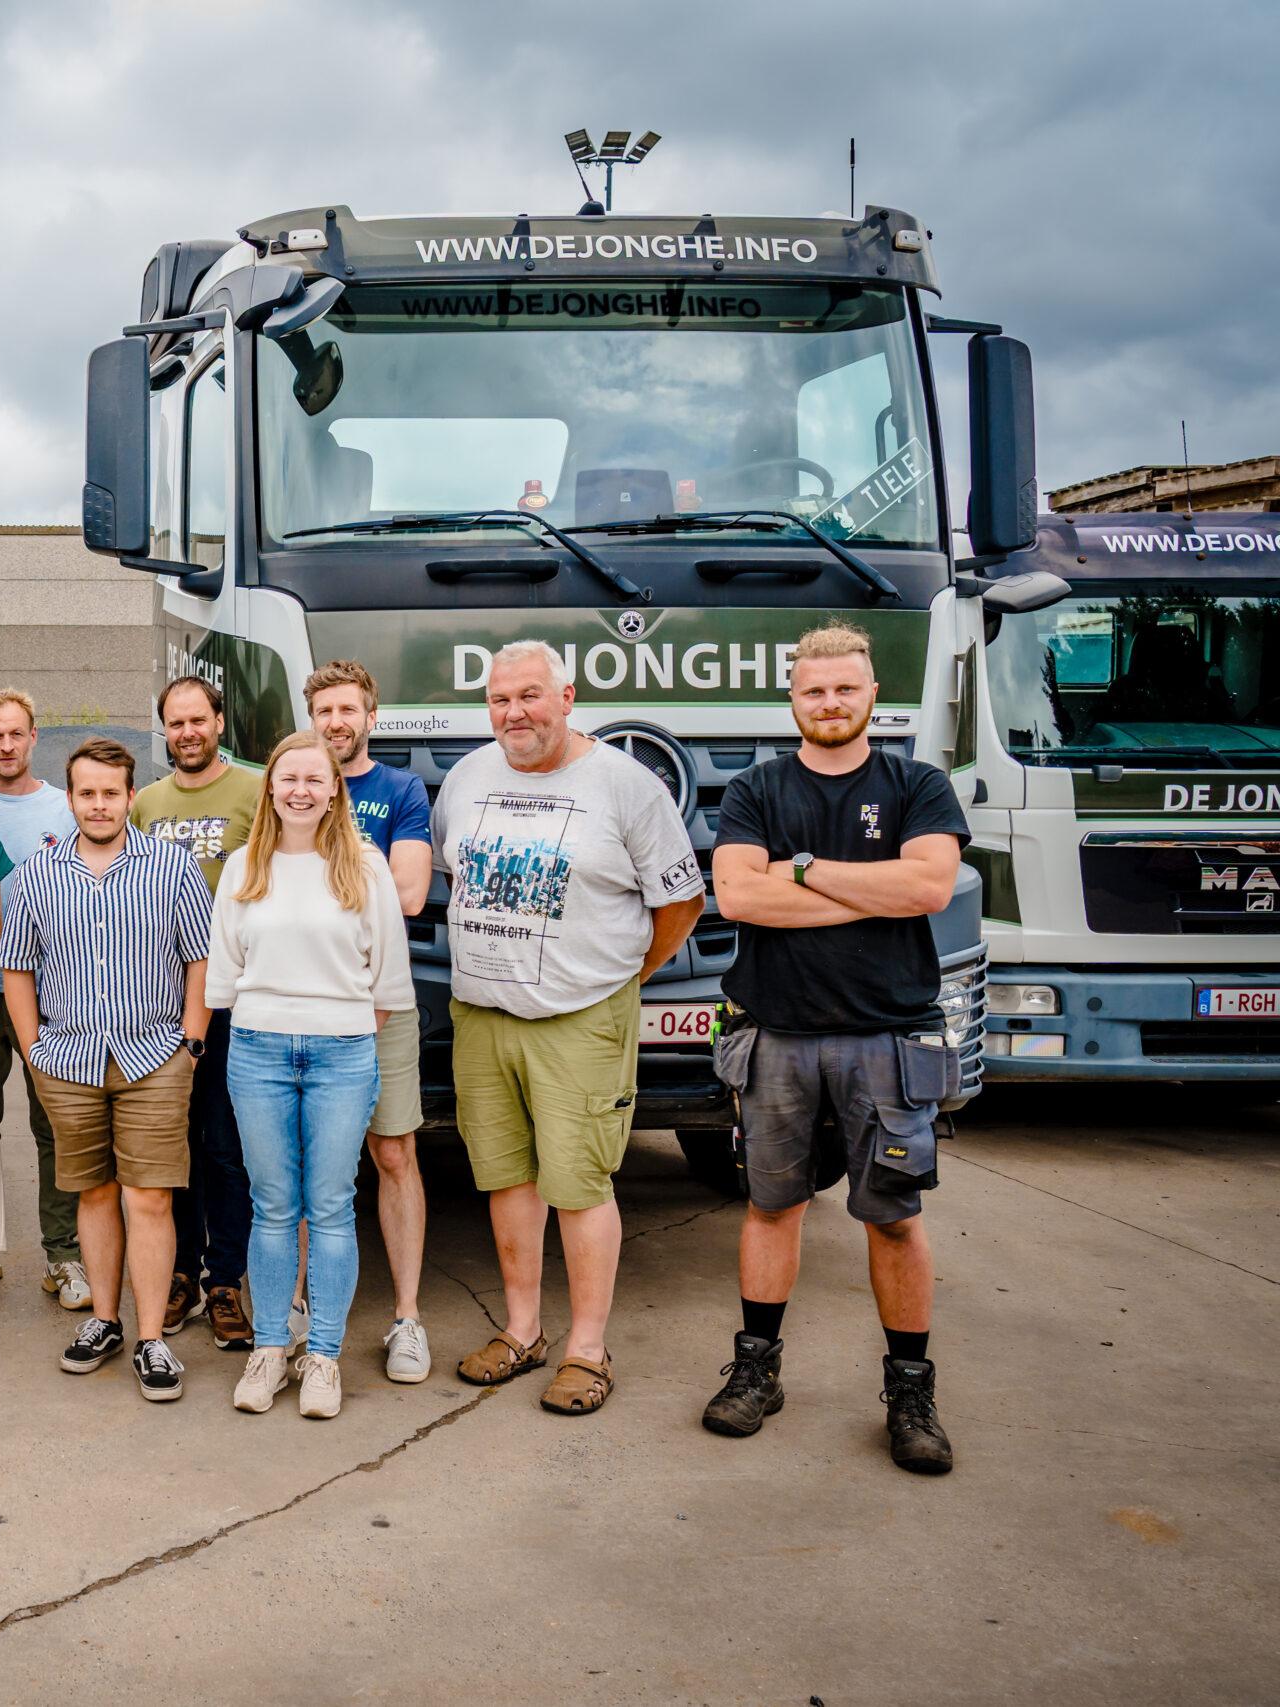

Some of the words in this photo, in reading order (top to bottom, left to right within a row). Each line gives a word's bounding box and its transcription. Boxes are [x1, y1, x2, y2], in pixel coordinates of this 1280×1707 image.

[416, 235, 817, 263] WWW.DEJONGHE.INFO
[453, 644, 506, 690] D
[374, 716, 449, 733] reenooghe
[499, 799, 556, 812] MANHATTAN
[1163, 784, 1211, 812] DE
[483, 871, 523, 908] 96
[463, 920, 481, 934] NEW
[483, 923, 507, 938] YORK
[508, 926, 533, 940] CITY
